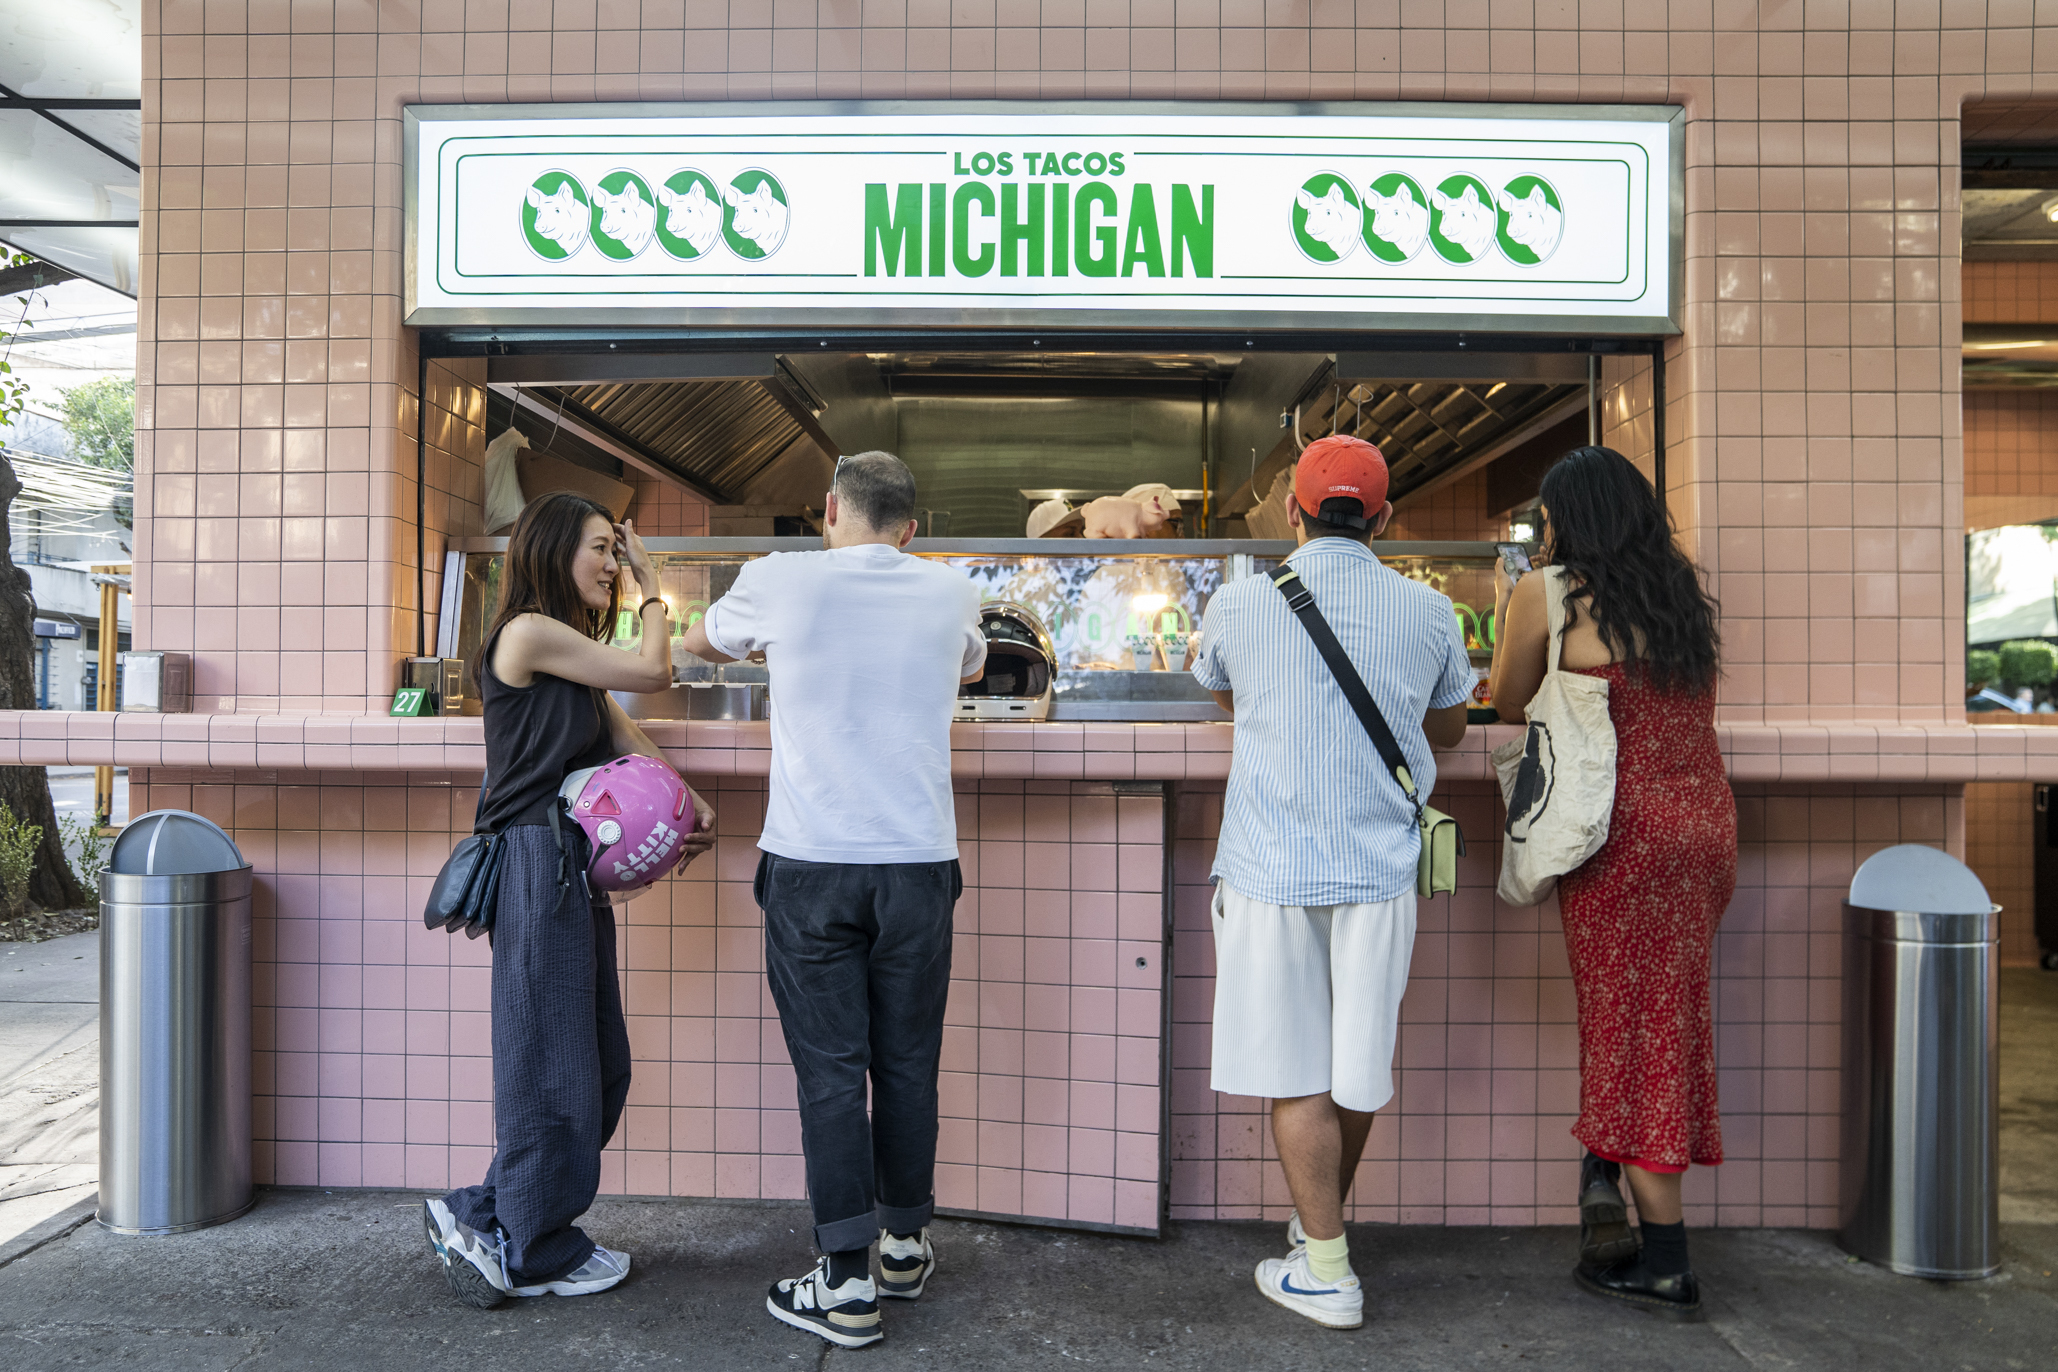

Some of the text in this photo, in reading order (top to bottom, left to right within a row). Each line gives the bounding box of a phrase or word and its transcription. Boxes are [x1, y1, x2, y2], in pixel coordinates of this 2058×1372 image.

[954, 151, 1126, 177] LOS TACOS
[864, 180, 1215, 278] MICHIGAN
[1328, 485, 1360, 493] SUPREME
[393, 691, 421, 713] 27
[613, 820, 669, 874] KITTY
[620, 828, 679, 882] HELLO
[793, 1282, 815, 1310] N
